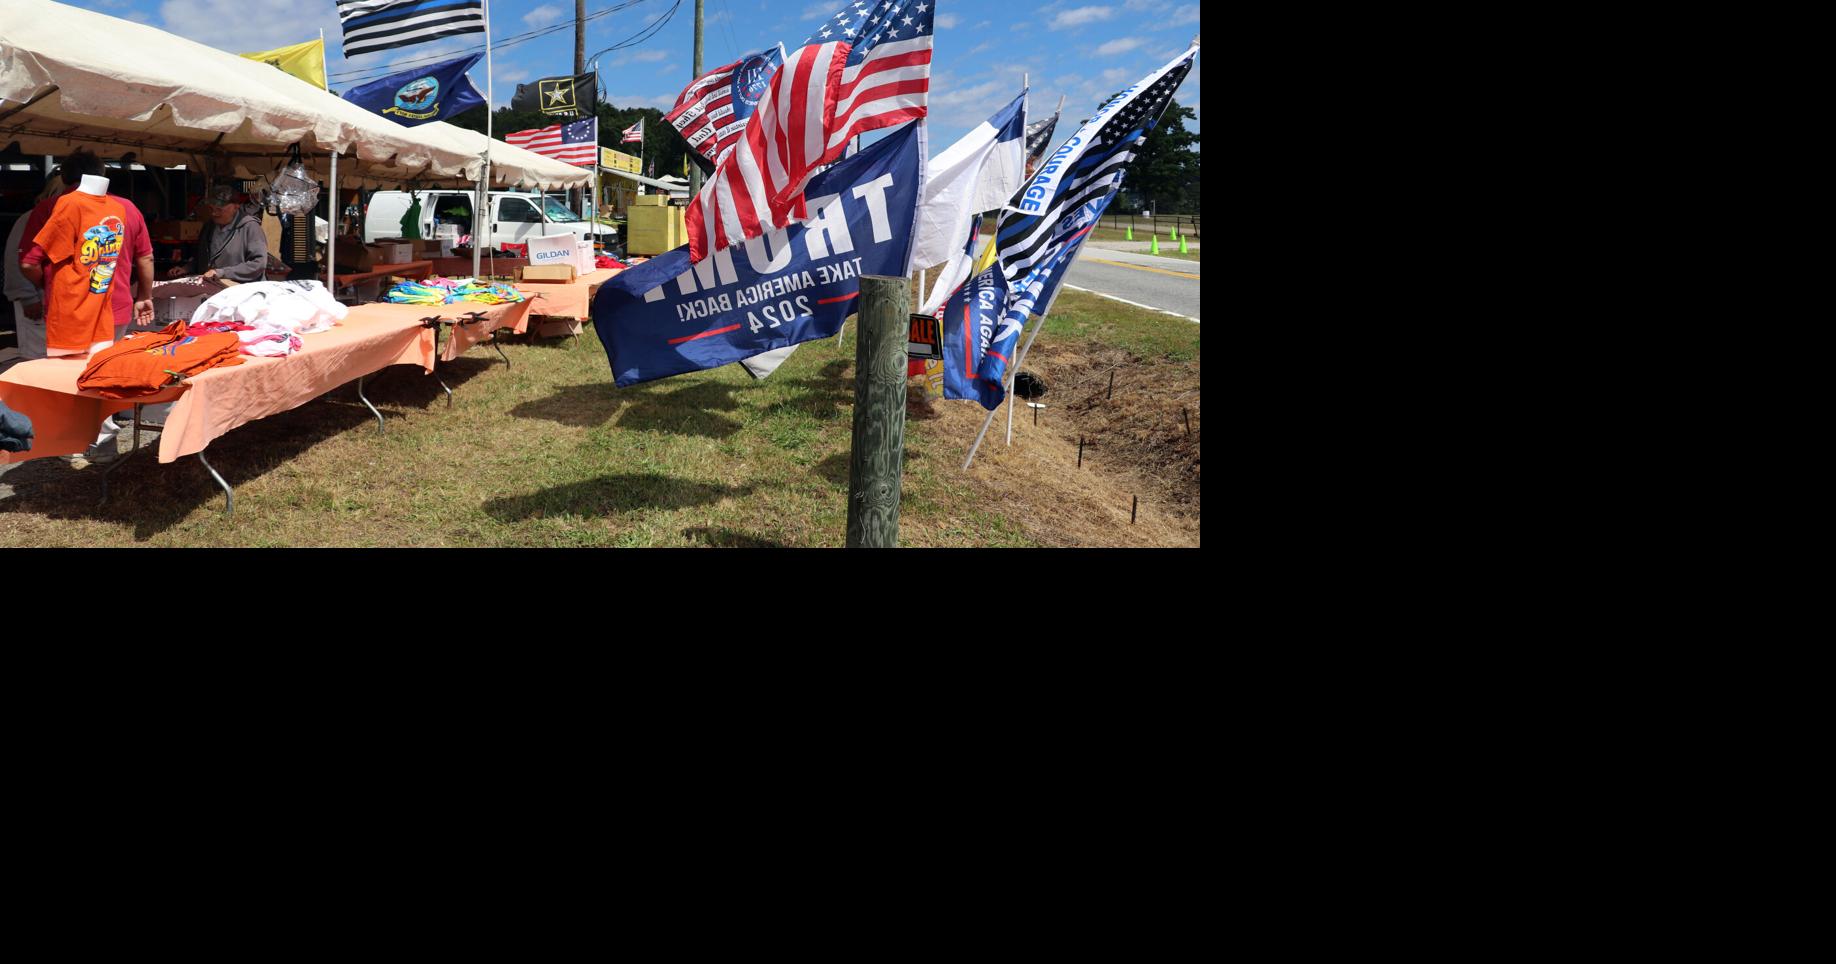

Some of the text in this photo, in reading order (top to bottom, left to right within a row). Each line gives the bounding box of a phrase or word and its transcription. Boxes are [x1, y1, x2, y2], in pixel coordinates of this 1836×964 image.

[1019, 136, 1082, 212] COURAGE
[536, 249, 570, 260] GILDAN
[911, 318, 935, 345] ALE
